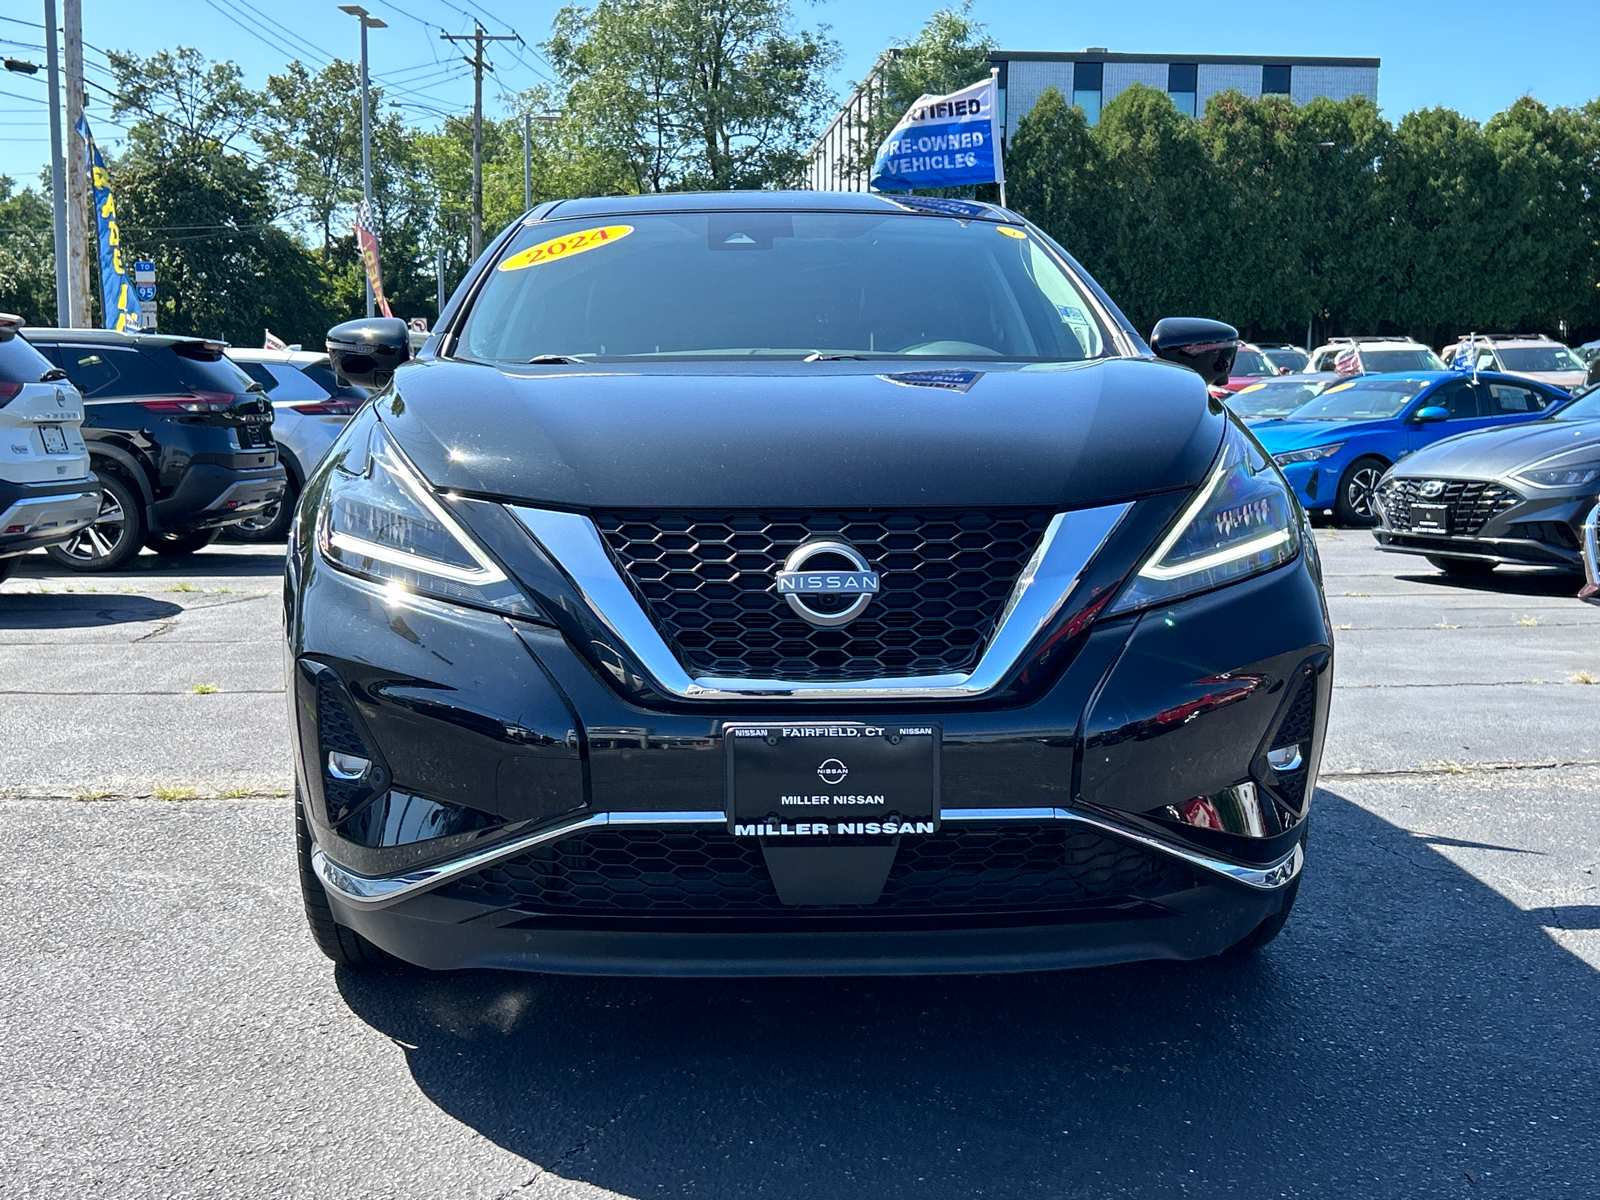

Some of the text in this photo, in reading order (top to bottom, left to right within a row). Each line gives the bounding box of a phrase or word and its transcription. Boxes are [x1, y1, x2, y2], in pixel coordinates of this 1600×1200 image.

[901, 98, 981, 124] RTIFIED
[880, 131, 984, 159] PRE-OWNED
[886, 152, 977, 175] VEHICLES
[526, 229, 612, 264] 2024
[139, 288, 153, 298] 95
[780, 577, 877, 590] NISSAN
[735, 729, 768, 737] NISSAN
[782, 727, 885, 738] FAIRFIELD, CT
[781, 795, 885, 805] MILLER NISSAN
[735, 822, 934, 836] MILLER NISSAN
